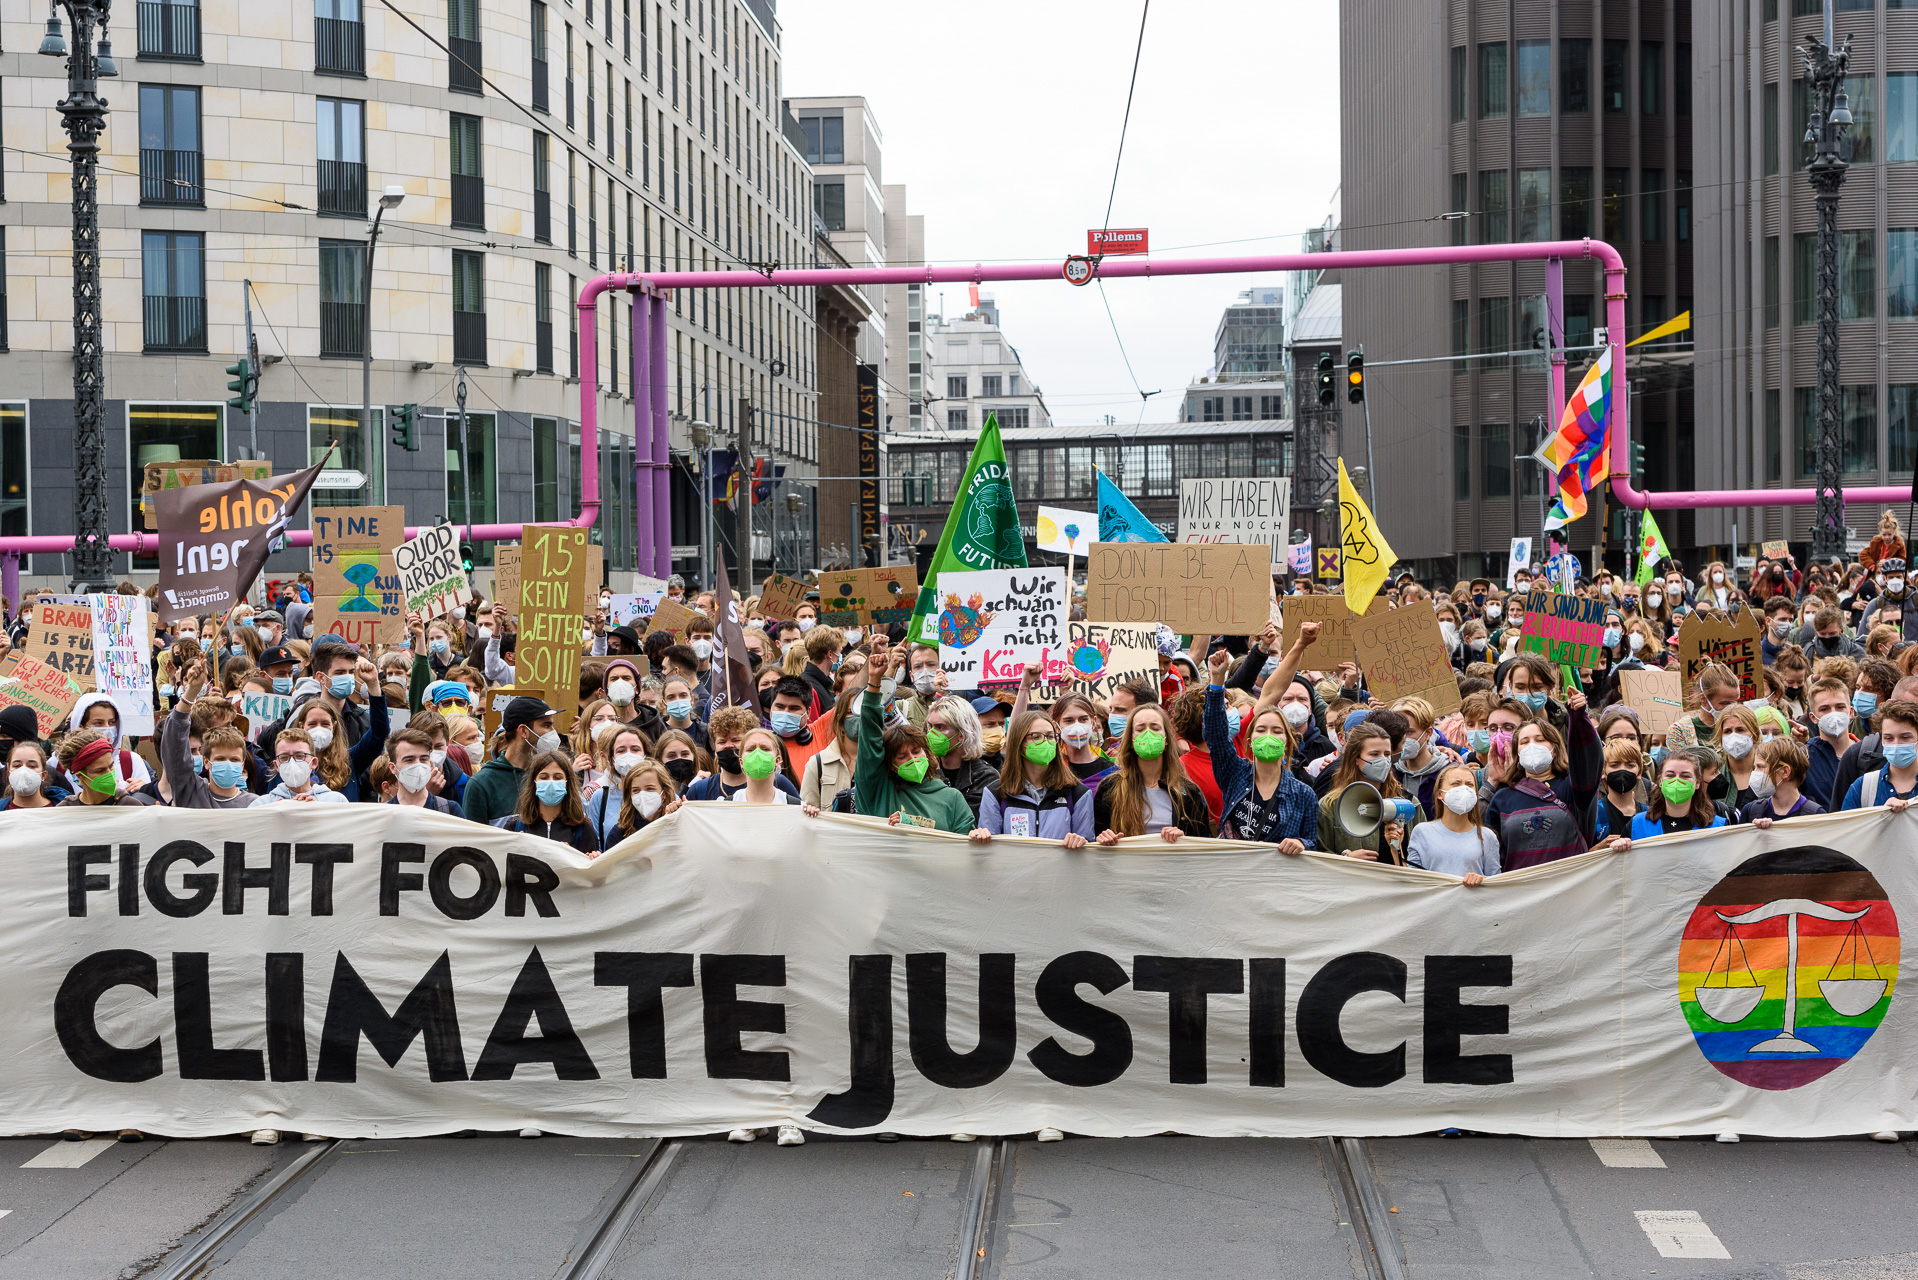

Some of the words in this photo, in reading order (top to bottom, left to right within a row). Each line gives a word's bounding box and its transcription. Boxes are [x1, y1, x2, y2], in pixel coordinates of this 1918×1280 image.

[1093, 231, 1143, 243] Pollems
[316, 476, 351, 484] useumsinsel
[1181, 481, 1212, 519] WIR
[1220, 480, 1286, 519] HABEN
[314, 516, 379, 540] TIME
[1189, 521, 1221, 530] NUR
[1233, 521, 1281, 530] NOCH
[316, 543, 334, 565] IS
[396, 525, 453, 571] QUOD
[406, 548, 460, 599] ARBOR
[874, 569, 896, 581] heute
[1098, 548, 1171, 580] DON'T
[1180, 547, 1213, 580] BE
[1230, 549, 1254, 581] A
[522, 580, 569, 609] KEIN
[1010, 576, 1057, 595] Wir
[96, 595, 138, 611] NIEMAND
[382, 592, 399, 604] NI
[1099, 583, 1177, 622] FOSSIL
[1181, 585, 1246, 624] FOOL
[1287, 598, 1333, 617] PAUSE
[1526, 591, 1548, 614] WIR
[1549, 594, 1580, 621] SIND
[1578, 598, 1610, 627] JUNG
[97, 608, 117, 623] WIRD
[120, 609, 131, 623] DIE
[381, 606, 400, 616] NG
[43, 631, 60, 646] IS
[98, 620, 131, 636] ZUKUNFT
[328, 619, 382, 645] OUT
[520, 613, 583, 645] WEITER
[1004, 628, 1062, 651] nicht,
[1109, 628, 1157, 651] BRENNT
[1362, 611, 1432, 649] OCEANS
[1522, 612, 1537, 635] &
[1541, 614, 1606, 647] BRAUCHEN
[1386, 633, 1421, 656] RISE
[1698, 637, 1754, 659] HÄTTE
[100, 650, 125, 663] DENN
[126, 651, 138, 664] DIE
[518, 646, 575, 690] SO!!!
[941, 651, 977, 673] wir
[982, 647, 1068, 680] Kämfen
[1375, 643, 1440, 677] FORESTS
[11, 668, 33, 682] MIR
[20, 658, 43, 676] ICH
[44, 669, 68, 687] BIN
[98, 661, 127, 676] WELT
[130, 662, 149, 677] WIRD
[1395, 663, 1431, 687] BURN
[1626, 673, 1678, 697] NOW
[66, 839, 354, 918] FIGHT
[379, 841, 561, 921] FOR
[53, 945, 791, 1084] CLIMATE
[805, 950, 1514, 1129] JUSTICE
